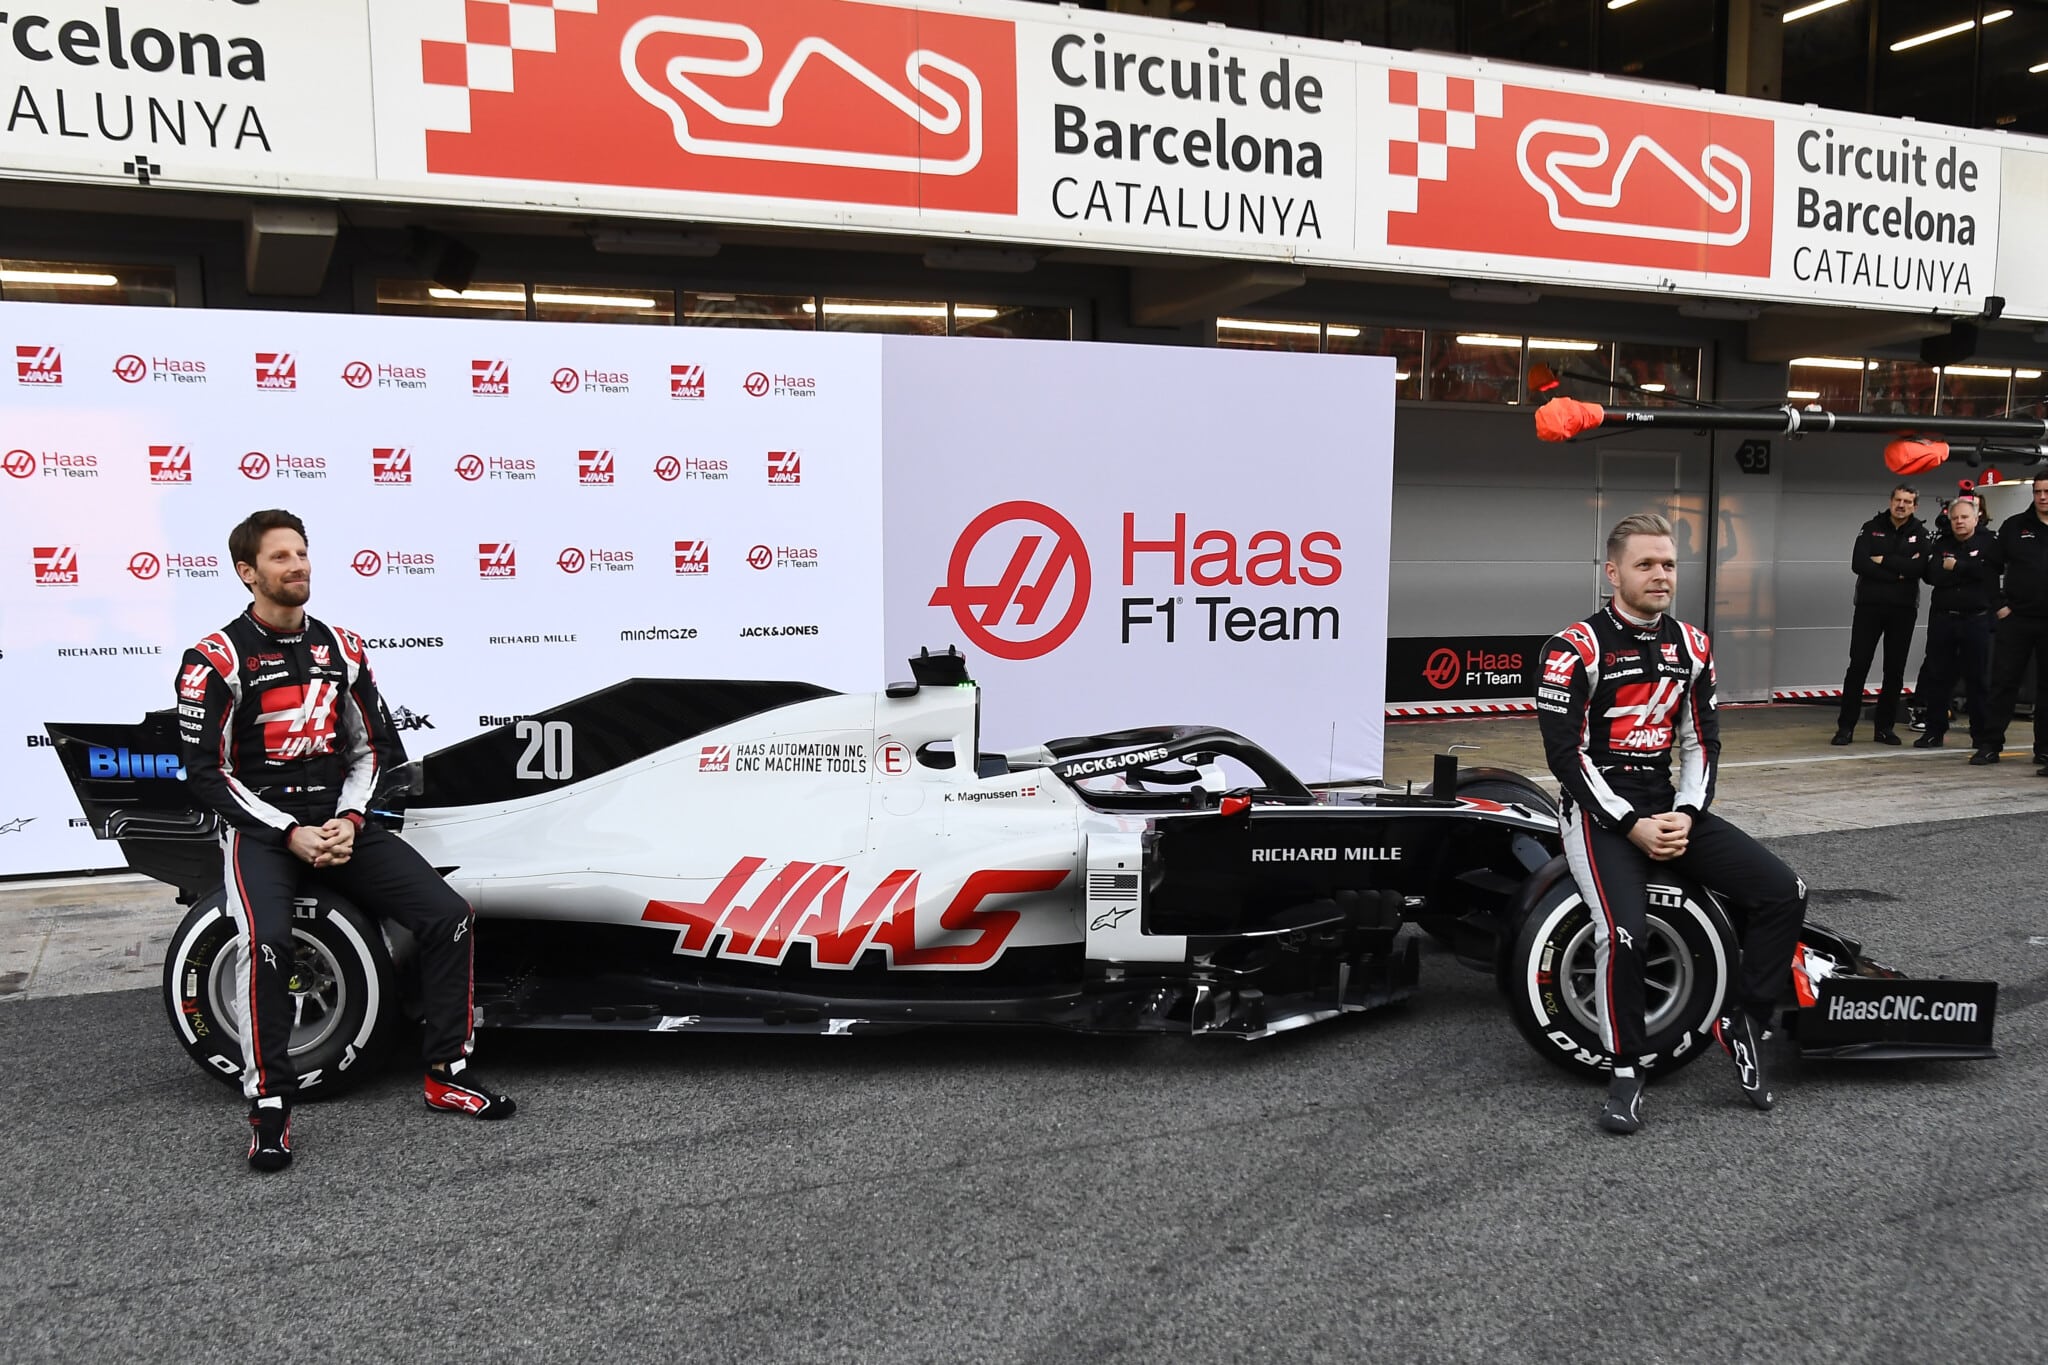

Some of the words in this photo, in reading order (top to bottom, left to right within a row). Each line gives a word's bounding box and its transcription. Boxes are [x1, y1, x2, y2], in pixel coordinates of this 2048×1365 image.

[0, 6, 265, 82] celona
[1051, 32, 1247, 106] Circuit
[1260, 58, 1323, 114] de
[1054, 103, 1322, 179] Barcelona
[1797, 128, 1927, 187] Circuit
[1935, 146, 1978, 193] de
[1052, 176, 1322, 240] CATALUNYA
[1797, 186, 1976, 246] Barcelona
[1793, 246, 1971, 296] CATALUNYA
[153, 357, 206, 372] Haas
[378, 364, 426, 378] Haas
[153, 373, 168, 383] F1
[171, 373, 206, 384] Team
[378, 378, 391, 388] F1
[394, 379, 427, 389] Team
[585, 370, 629, 383] Haas
[774, 374, 815, 387] Haas
[585, 384, 597, 393] F1
[600, 384, 629, 393] Team
[774, 387, 786, 396] F1
[789, 388, 815, 397] Team
[42, 452, 97, 467] Haas
[276, 454, 326, 468] Haas
[489, 457, 535, 470] Haas
[1744, 445, 1768, 468] 33
[686, 458, 728, 471] Haas
[43, 467, 58, 478] F1
[61, 467, 98, 478] Team
[276, 469, 290, 479] F1
[293, 469, 327, 479] Team
[490, 470, 502, 480] F1
[505, 471, 536, 480] Team
[686, 471, 698, 480] F1
[701, 471, 728, 480] Team
[590, 549, 633, 562] Haas
[777, 546, 817, 559] Haas
[1122, 512, 1342, 587] Haas
[166, 553, 218, 567] Haas
[387, 551, 434, 565] Haas
[777, 559, 788, 568] F1
[791, 559, 818, 568] Team
[167, 567, 180, 578] F1
[183, 567, 219, 578] Team
[387, 565, 400, 575] F1
[403, 565, 435, 575] Team
[590, 562, 602, 571] F1
[605, 562, 634, 571] Team
[1196, 596, 1340, 642] Team
[621, 625, 698, 641] mindmaze
[739, 625, 819, 638] JACK&JONES
[362, 637, 444, 649] ACK&JONES
[490, 635, 540, 645] RICHARD
[544, 634, 577, 643] MILLE
[58, 647, 118, 657] RICHARD
[123, 646, 162, 655] MILLE
[1466, 650, 1522, 670] Haas
[1466, 672, 1481, 686] F1
[1484, 671, 1521, 685] Team
[392, 714, 437, 731] EAK
[515, 720, 573, 780] 20
[737, 745, 765, 756] HAAS
[769, 743, 840, 757] AUTOMATION
[844, 745, 867, 758] INC.
[89, 747, 180, 778] Blue
[735, 757, 761, 771] CNC
[765, 757, 822, 772] MACHINE
[825, 758, 867, 773] TOOLS
[885, 747, 902, 772] E
[1063, 748, 1169, 779] JACK&JONES
[944, 792, 955, 802] K.
[958, 788, 1018, 803] Magnussen
[1252, 848, 1338, 862] RICHARD
[1345, 847, 1402, 861] MILLE
[641, 856, 1071, 971] HAAS
[1828, 995, 1978, 1022] HaasCNC.com
